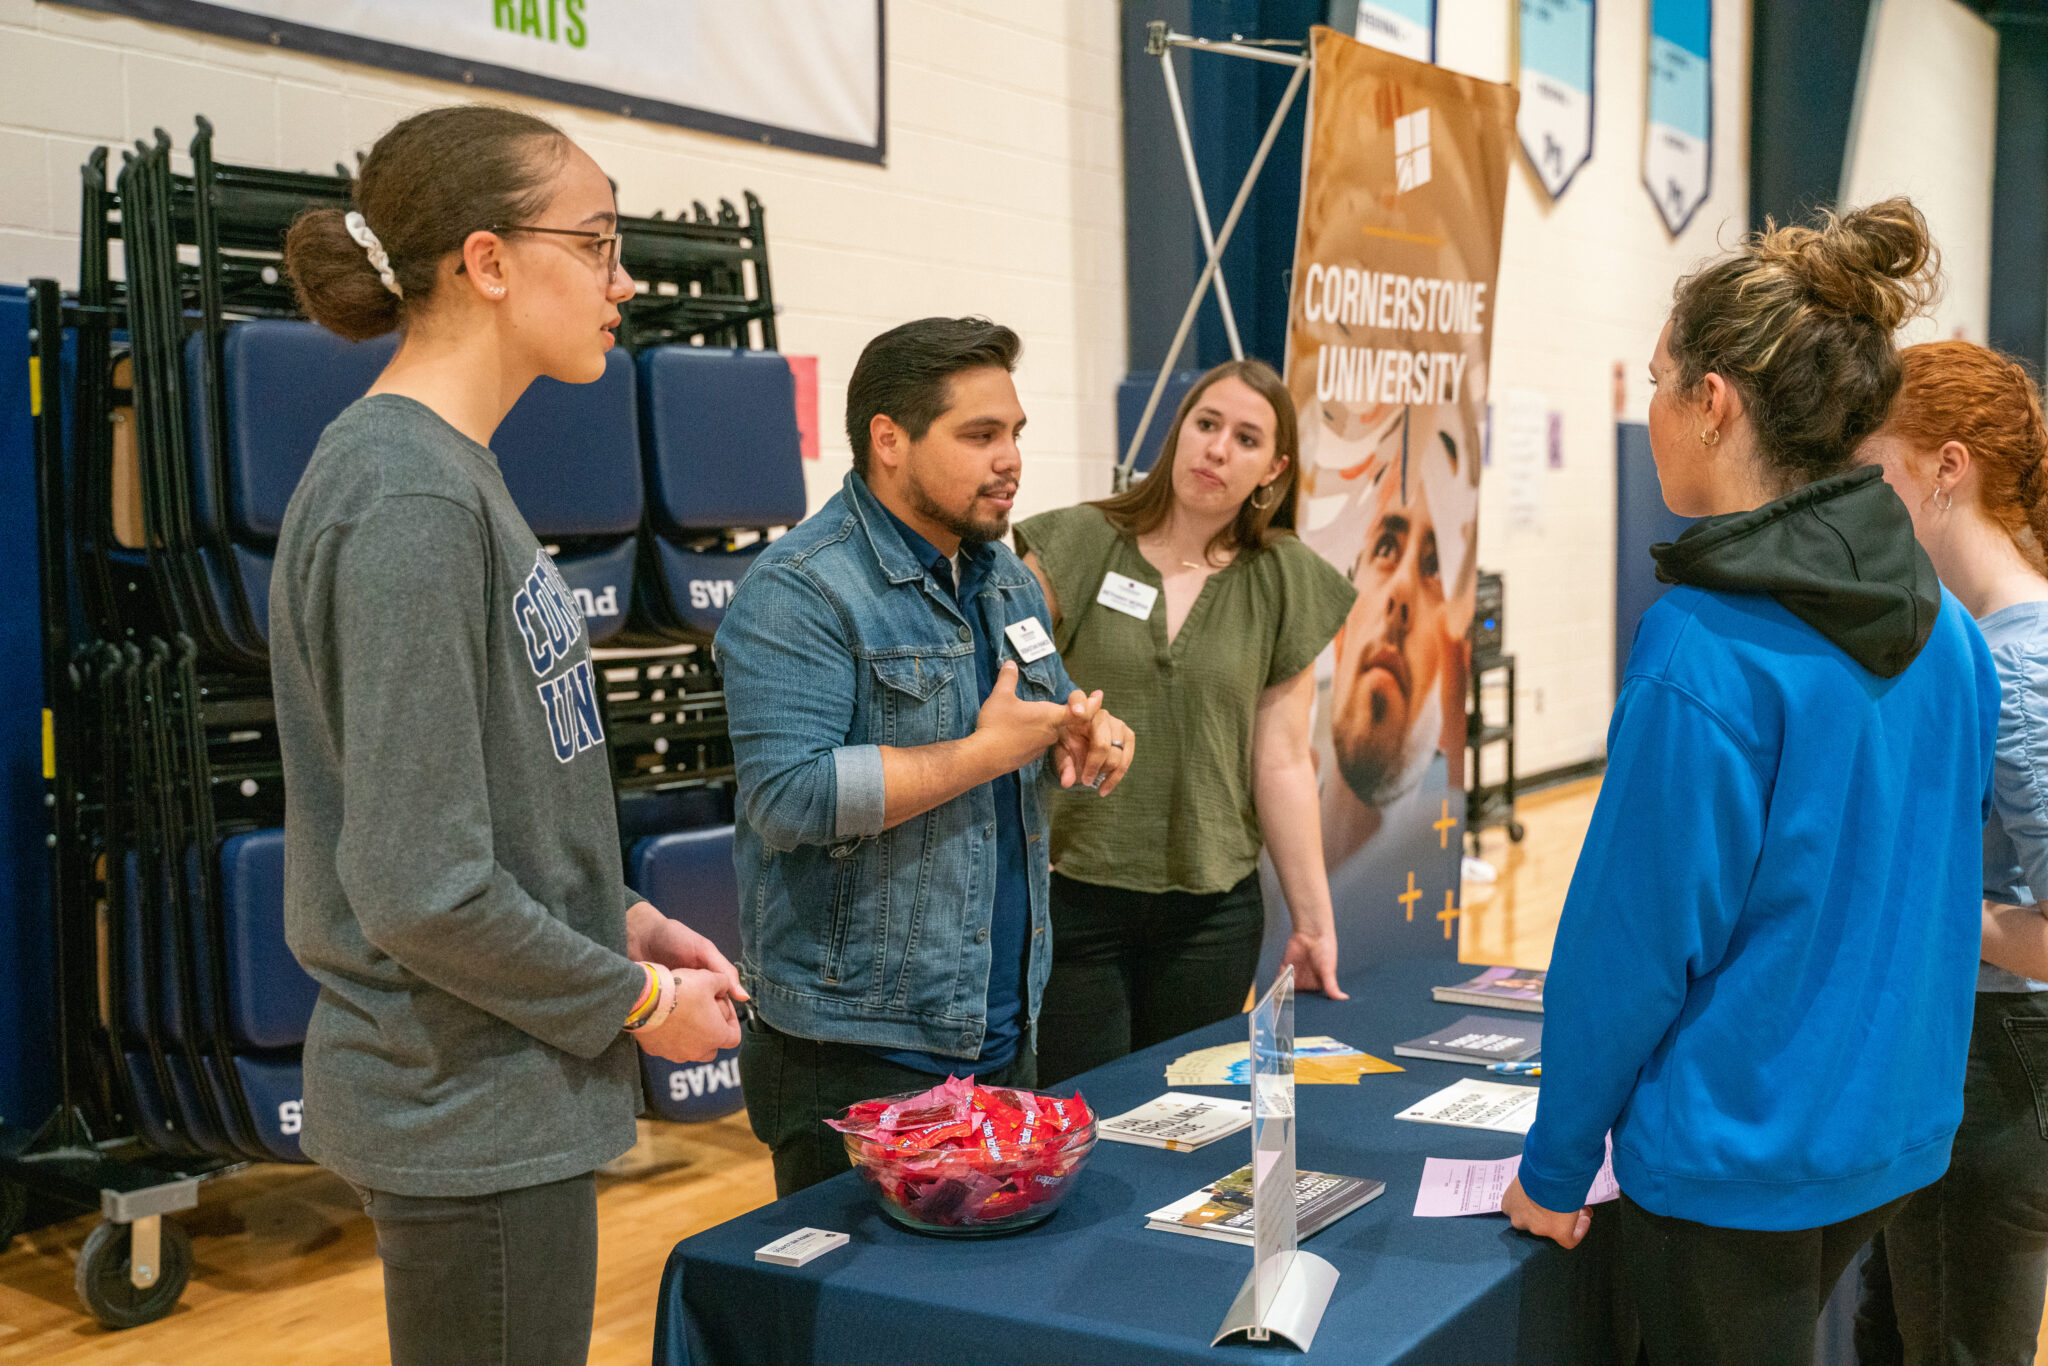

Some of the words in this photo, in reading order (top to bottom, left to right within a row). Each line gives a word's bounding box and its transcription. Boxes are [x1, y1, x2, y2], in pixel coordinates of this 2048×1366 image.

[1304, 263, 1487, 334] CORNERSTONE
[1316, 345, 1467, 405] UNIVERSITY
[1106, 1117, 1152, 1130] DUAL
[1130, 1102, 1218, 1134] ENROLLMENT
[1156, 1123, 1206, 1138] GUIDE
